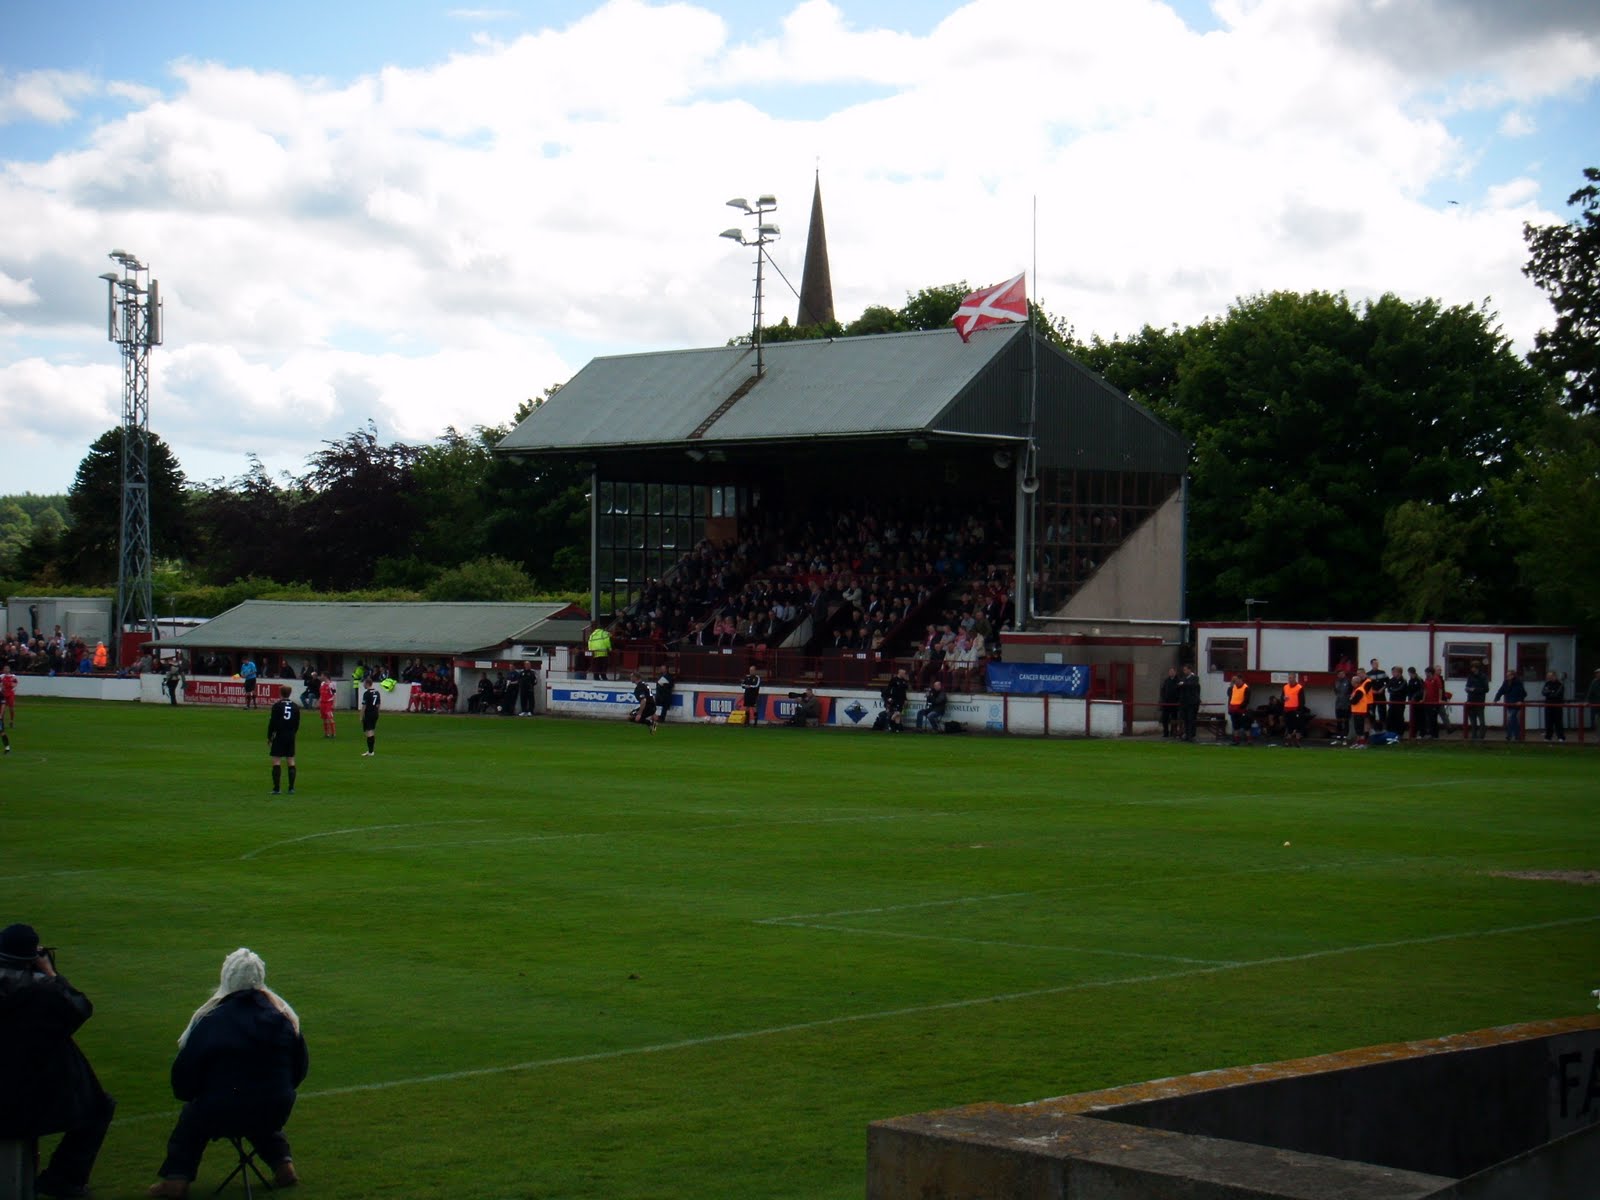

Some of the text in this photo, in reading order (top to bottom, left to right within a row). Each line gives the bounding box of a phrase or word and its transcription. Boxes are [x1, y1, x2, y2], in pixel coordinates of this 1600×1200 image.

[1019, 673, 1039, 681] CANCER
[195, 682, 217, 695] James
[257, 684, 271, 697] Ltd
[372, 695, 378, 705] 7
[710, 700, 732, 712] IRN-BRU
[283, 706, 292, 720] 5
